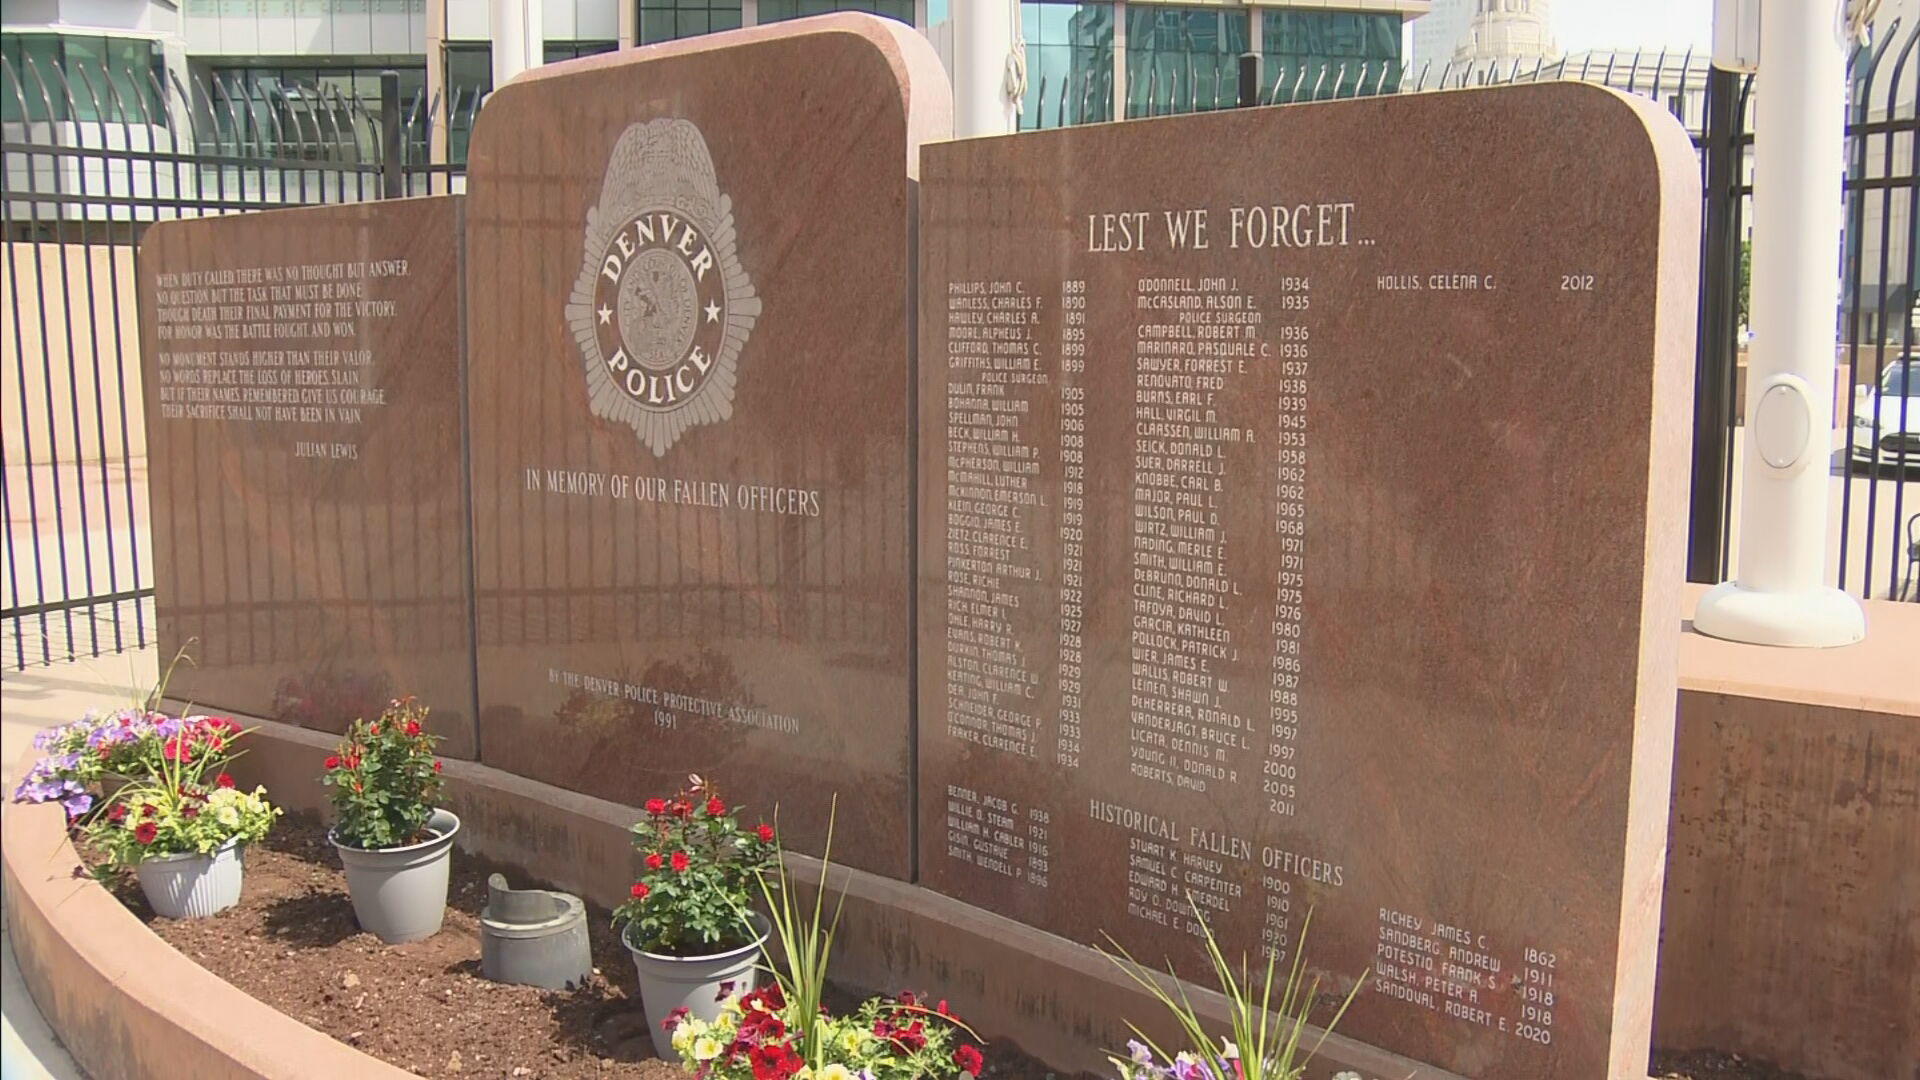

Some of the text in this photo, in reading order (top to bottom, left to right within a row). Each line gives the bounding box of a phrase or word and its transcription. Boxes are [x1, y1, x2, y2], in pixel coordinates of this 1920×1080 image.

[1088, 213, 1149, 252] LEST
[1164, 209, 1208, 249] WE
[602, 214, 713, 284] DENVER
[156, 273, 178, 288] WHEN
[182, 272, 201, 287] DUTY
[205, 270, 234, 285] CALLED
[236, 269, 263, 283] THERE
[266, 267, 283, 281] WAS
[286, 266, 298, 280] NO
[301, 264, 344, 280] THOUGHT
[348, 262, 364, 278] BUT
[989, 282, 1011, 293] JOHN
[1063, 281, 1085, 293] 1889
[1429, 275, 1476, 289] CELENA
[1484, 275, 1496, 289] C.
[1561, 275, 1593, 290] 2012
[157, 308, 189, 322] THOUGH
[192, 306, 217, 322] DEATH
[220, 306, 243, 321] THEIR
[246, 305, 270, 320] FINAL
[273, 304, 311, 319] PAYMENT
[315, 303, 332, 317] FOR
[335, 302, 352, 317] THE
[993, 343, 1028, 354] THOMAS
[1062, 344, 1085, 356] 1899
[607, 345, 711, 403] POLICE
[296, 441, 357, 459] JULIAN LEWIS
[973, 429, 1008, 441] WILLIAM
[1061, 435, 1083, 448] 1908
[1195, 427, 1240, 441] WILLIAM
[1279, 432, 1306, 446] 1953
[993, 444, 1029, 457] WILLIAM
[1060, 450, 1083, 463] 1908
[1171, 442, 1212, 457] DONALD
[1279, 450, 1306, 464] 1958
[1167, 458, 1212, 473] DARRELL
[1279, 468, 1305, 482] 1962
[527, 469, 819, 517] IN MEMORY OF OUR FALLEN OFFICERS
[1181, 476, 1208, 490] CARL
[1215, 479, 1223, 491] B.
[1277, 485, 1304, 499] 1962
[1176, 492, 1203, 506] PAUL
[1276, 502, 1304, 517] 1965
[1179, 509, 1205, 524] PAUL
[1276, 520, 1304, 535] 1968
[1171, 525, 1215, 541] WILLIAM
[1282, 538, 1303, 552] 1971
[1179, 542, 1212, 557] MERLE
[1218, 547, 1227, 559] E.
[1281, 555, 1303, 569] 1971
[1169, 558, 1212, 574] WILLIAM
[1218, 564, 1227, 576] E.
[1278, 572, 1303, 587] 1975
[1187, 576, 1228, 592] DONALD
[1277, 588, 1302, 603] 1975
[1168, 589, 1214, 607] RICHARD
[1275, 605, 1301, 620] 1976
[1179, 607, 1211, 623] DAVID
[1272, 622, 1300, 637] 1980
[1178, 623, 1230, 642] KATHLEEN
[1276, 640, 1300, 654] 1981
[1163, 653, 1195, 670] JAMES
[1273, 673, 1299, 688] 1987
[1182, 640, 1226, 659] PATRICK
[1273, 656, 1300, 672] 1986
[563, 671, 579, 688] THE
[584, 676, 620, 697] DENVER
[625, 684, 657, 705] POLICE
[664, 692, 723, 718] PROTECTIVE
[729, 707, 798, 734] ASSOCIATION
[654, 710, 677, 729] 1991
[1090, 799, 1343, 887] HISTORICAL FALLEN OFFICERS
[1130, 838, 1290, 894] STUART K HARVEY 1900
[1129, 855, 1289, 912] SAMUEL C CARPENTER 1910
[1129, 871, 1166, 891] EDWARD
[1172, 882, 1178, 895] H
[1266, 914, 1288, 930] 1961
[1379, 908, 1556, 968] RICHEY JAMES C. 1862
[1449, 947, 1500, 972] ANDREW
[1524, 967, 1552, 986] 1911
[1442, 963, 1481, 985] FRANK
[1522, 986, 1552, 1005] 1918
[1425, 975, 1462, 998] PETER
[1522, 1005, 1551, 1025] 1918
[1445, 1000, 1491, 1025] ROBERT
[1499, 1018, 1510, 1032] E.
[1516, 1022, 1550, 1044] 2020
